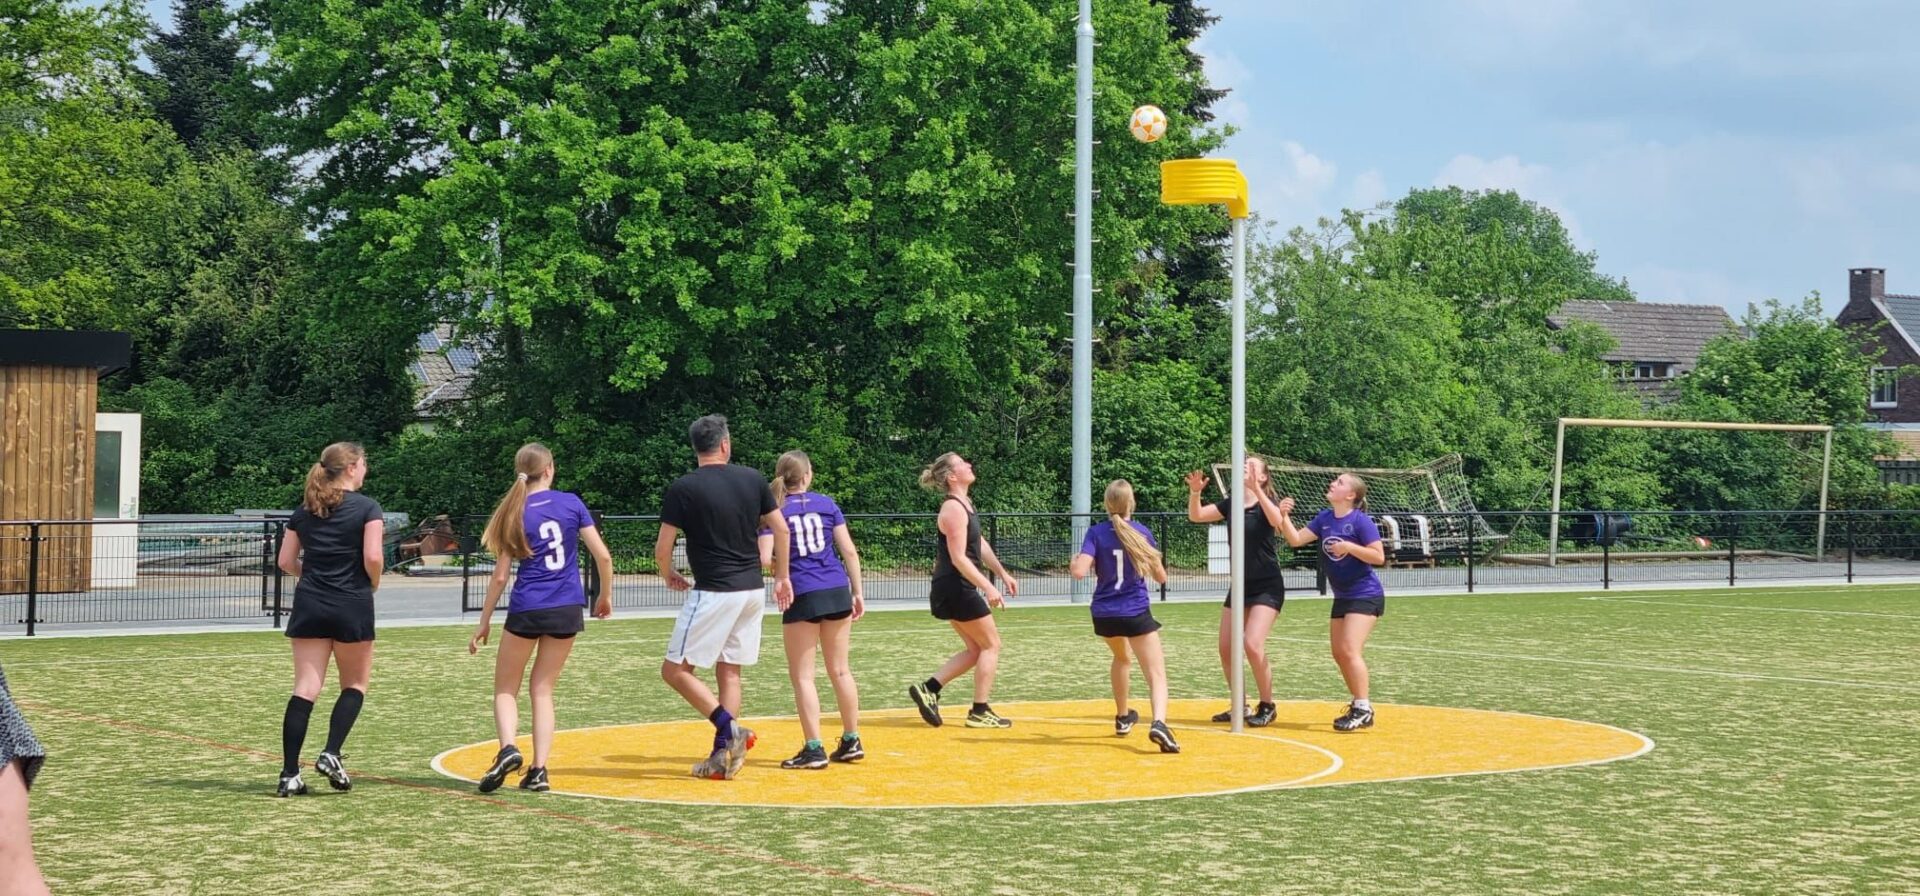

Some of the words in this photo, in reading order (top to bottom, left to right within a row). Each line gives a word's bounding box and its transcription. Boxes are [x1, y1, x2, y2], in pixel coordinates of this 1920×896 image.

[539, 520, 565, 570] 3
[789, 512, 826, 557] 10
[1113, 549, 1124, 590] 1
